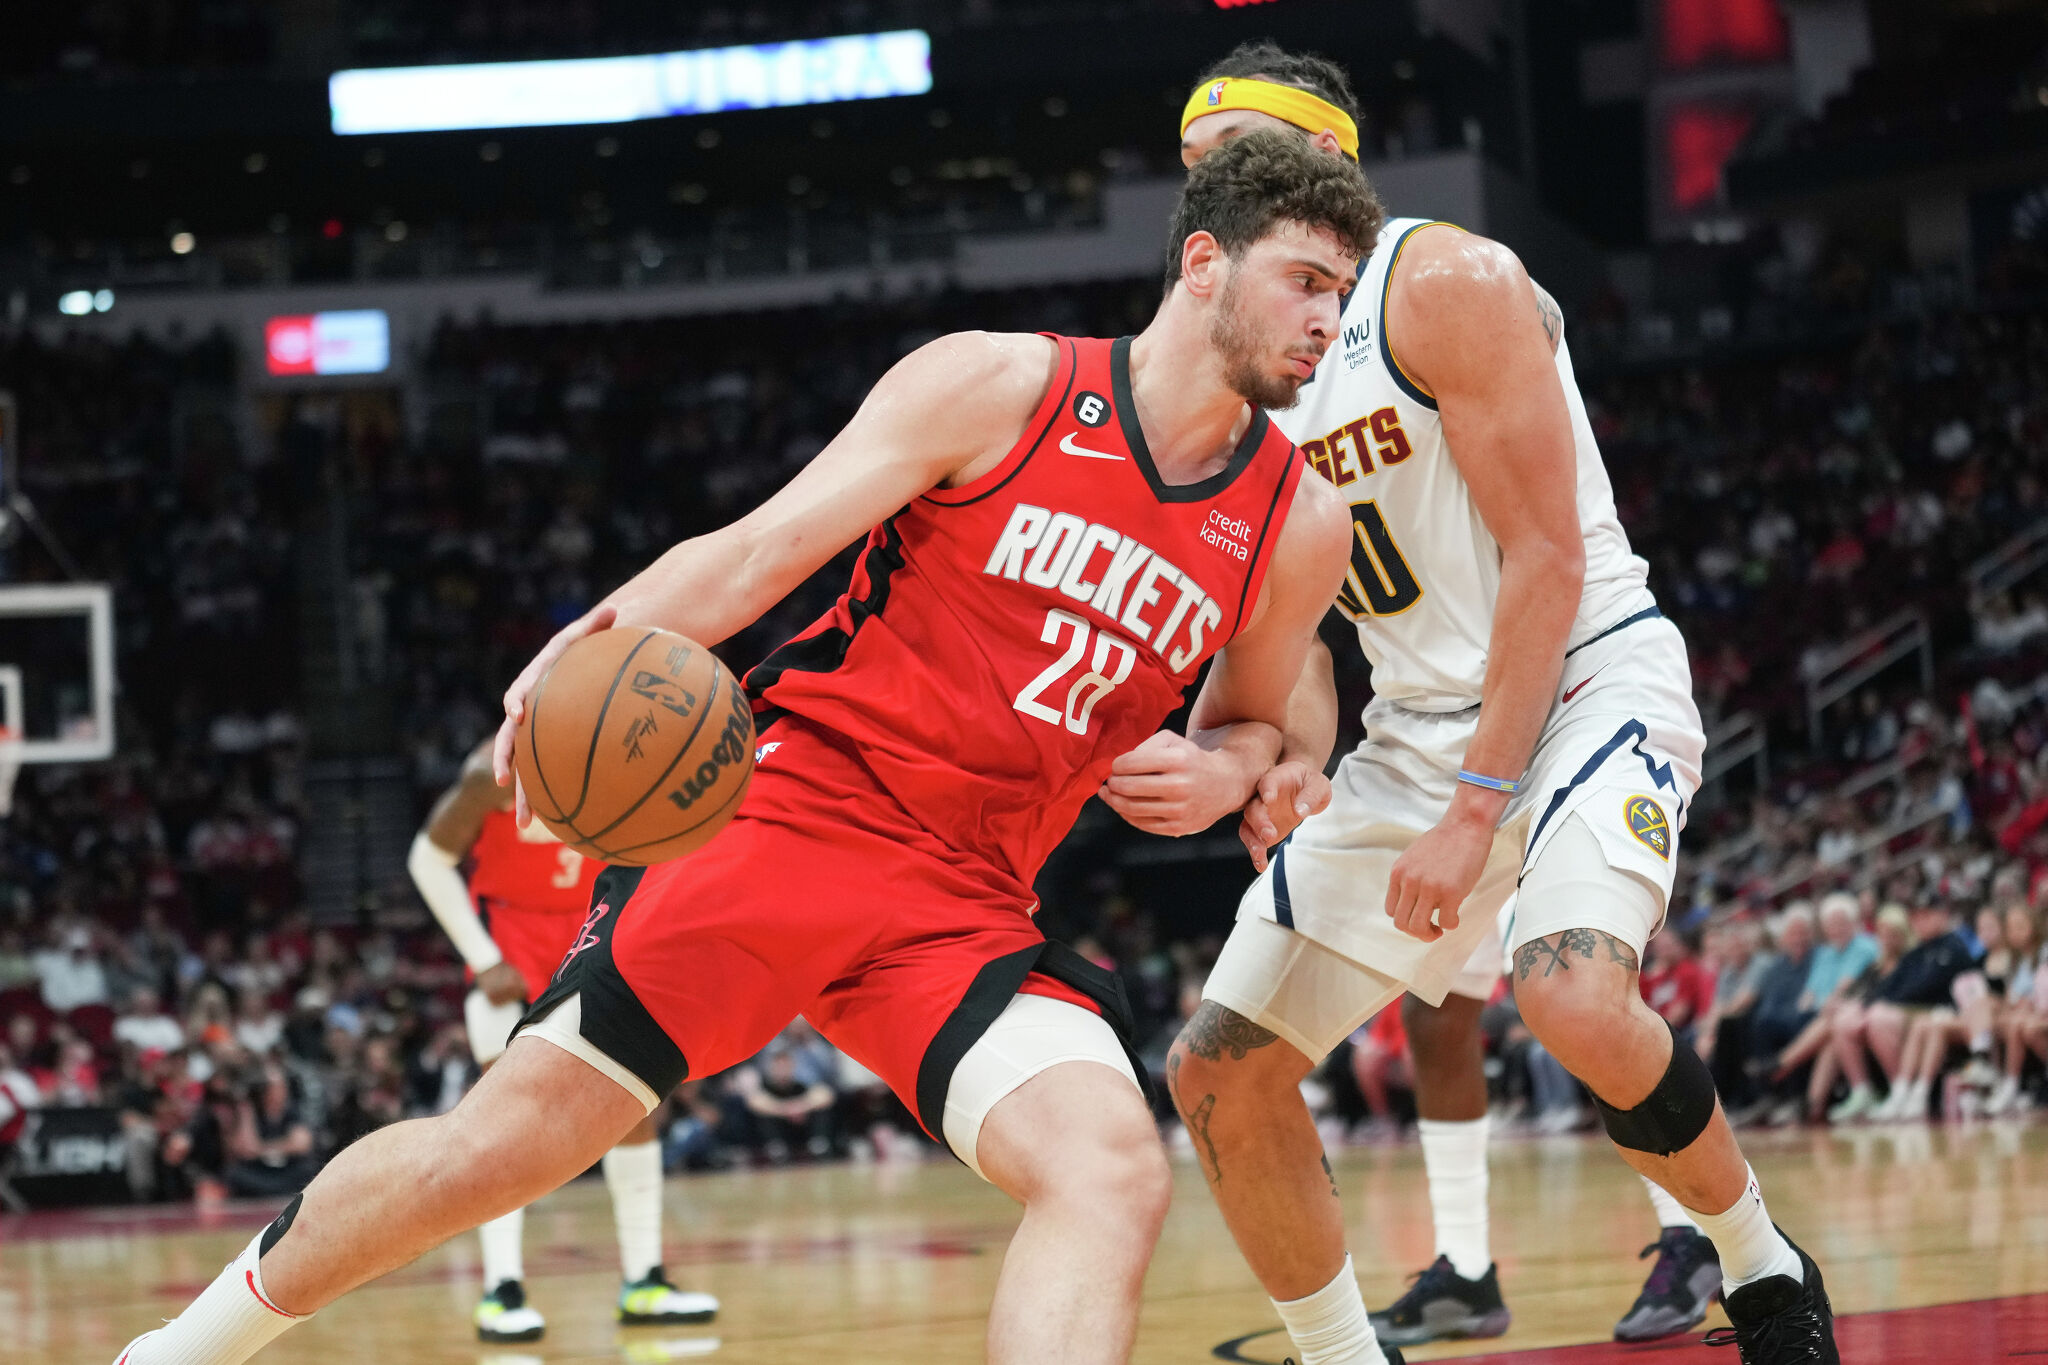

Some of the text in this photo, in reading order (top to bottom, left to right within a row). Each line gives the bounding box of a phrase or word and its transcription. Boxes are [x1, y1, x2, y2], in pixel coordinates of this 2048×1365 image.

[1343, 318, 1370, 349] WU
[1344, 343, 1372, 361] Western
[1350, 355, 1369, 370] Union
[1079, 396, 1104, 424] 6
[1199, 520, 1248, 562] karma
[1209, 509, 1252, 542] credit
[1336, 498, 1425, 618] 0
[982, 502, 1223, 675] ROCKETS
[1012, 607, 1137, 736] 28
